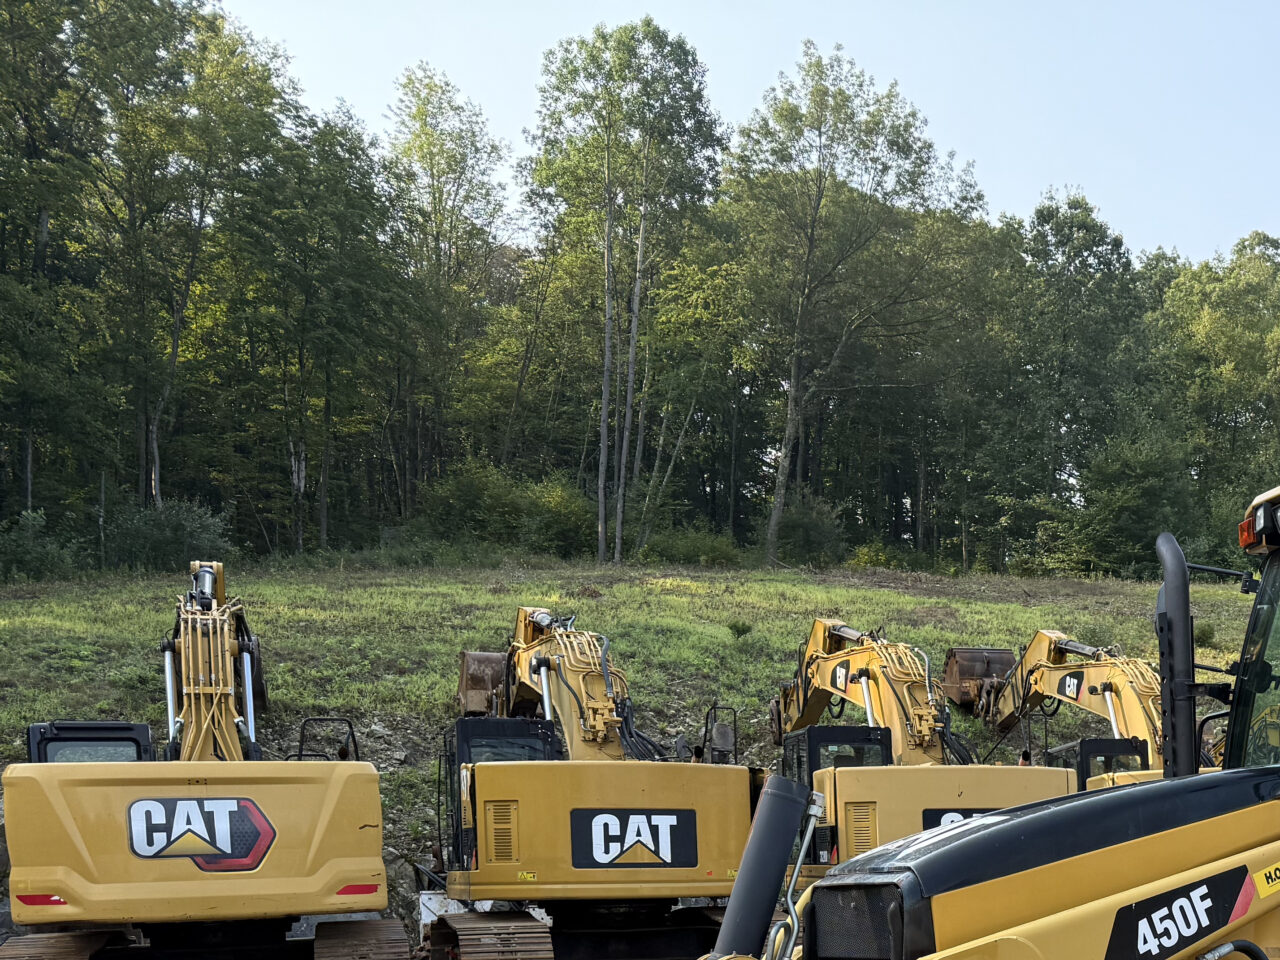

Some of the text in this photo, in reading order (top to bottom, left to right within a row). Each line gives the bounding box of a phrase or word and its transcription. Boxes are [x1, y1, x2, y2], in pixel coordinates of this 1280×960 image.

[130, 799, 238, 857] CAT
[591, 813, 678, 864] CAT
[1137, 884, 1213, 956] 450F
